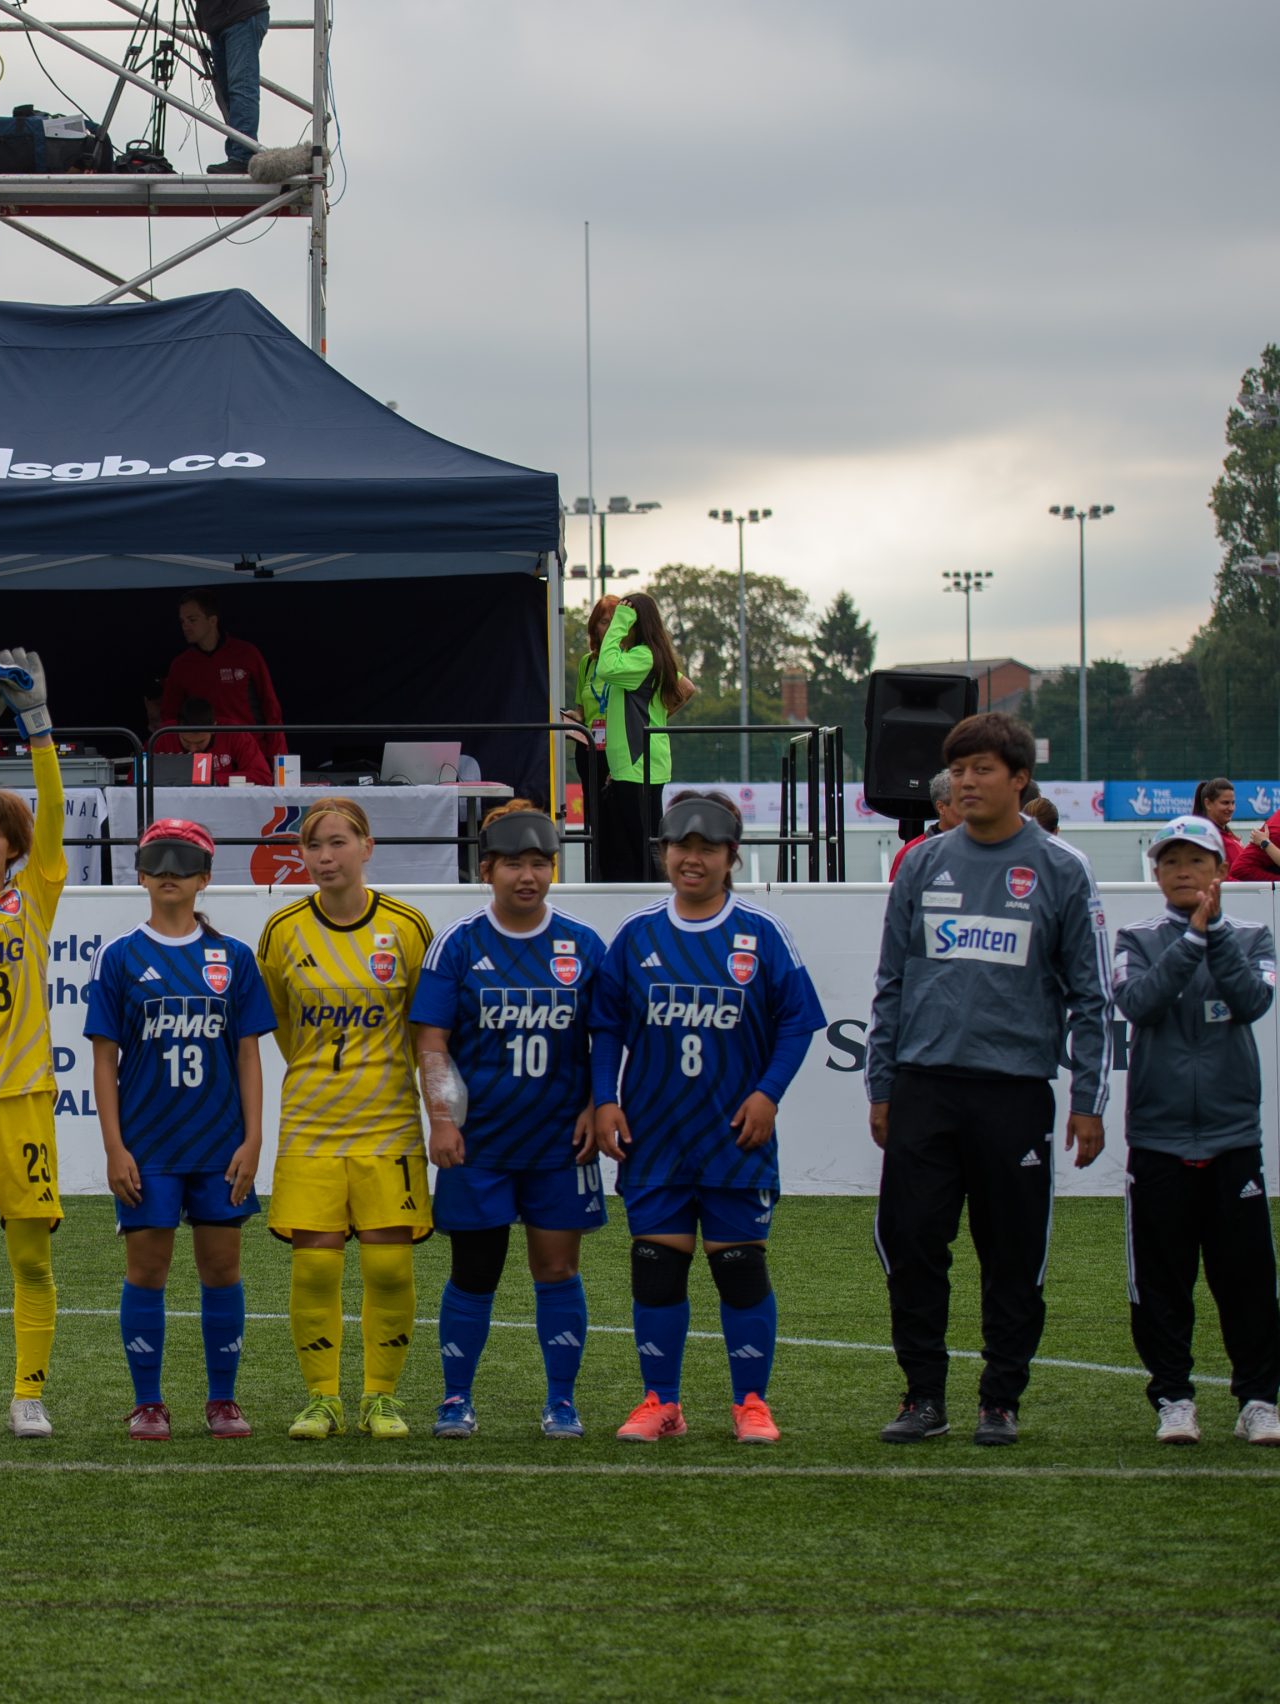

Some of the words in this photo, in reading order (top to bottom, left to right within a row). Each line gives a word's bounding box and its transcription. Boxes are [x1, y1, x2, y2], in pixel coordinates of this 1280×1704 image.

[198, 757, 207, 782] 1
[936, 920, 1017, 953] Santen
[142, 1014, 225, 1040] KPMG
[301, 1005, 385, 1027] KPMG
[479, 1005, 575, 1030] KPMG
[647, 1001, 740, 1030] KPMG
[163, 1045, 204, 1088] 13
[506, 1035, 548, 1077] 10
[681, 1034, 703, 1077] 8
[23, 1143, 51, 1183] 23
[395, 1156, 410, 1192] 1
